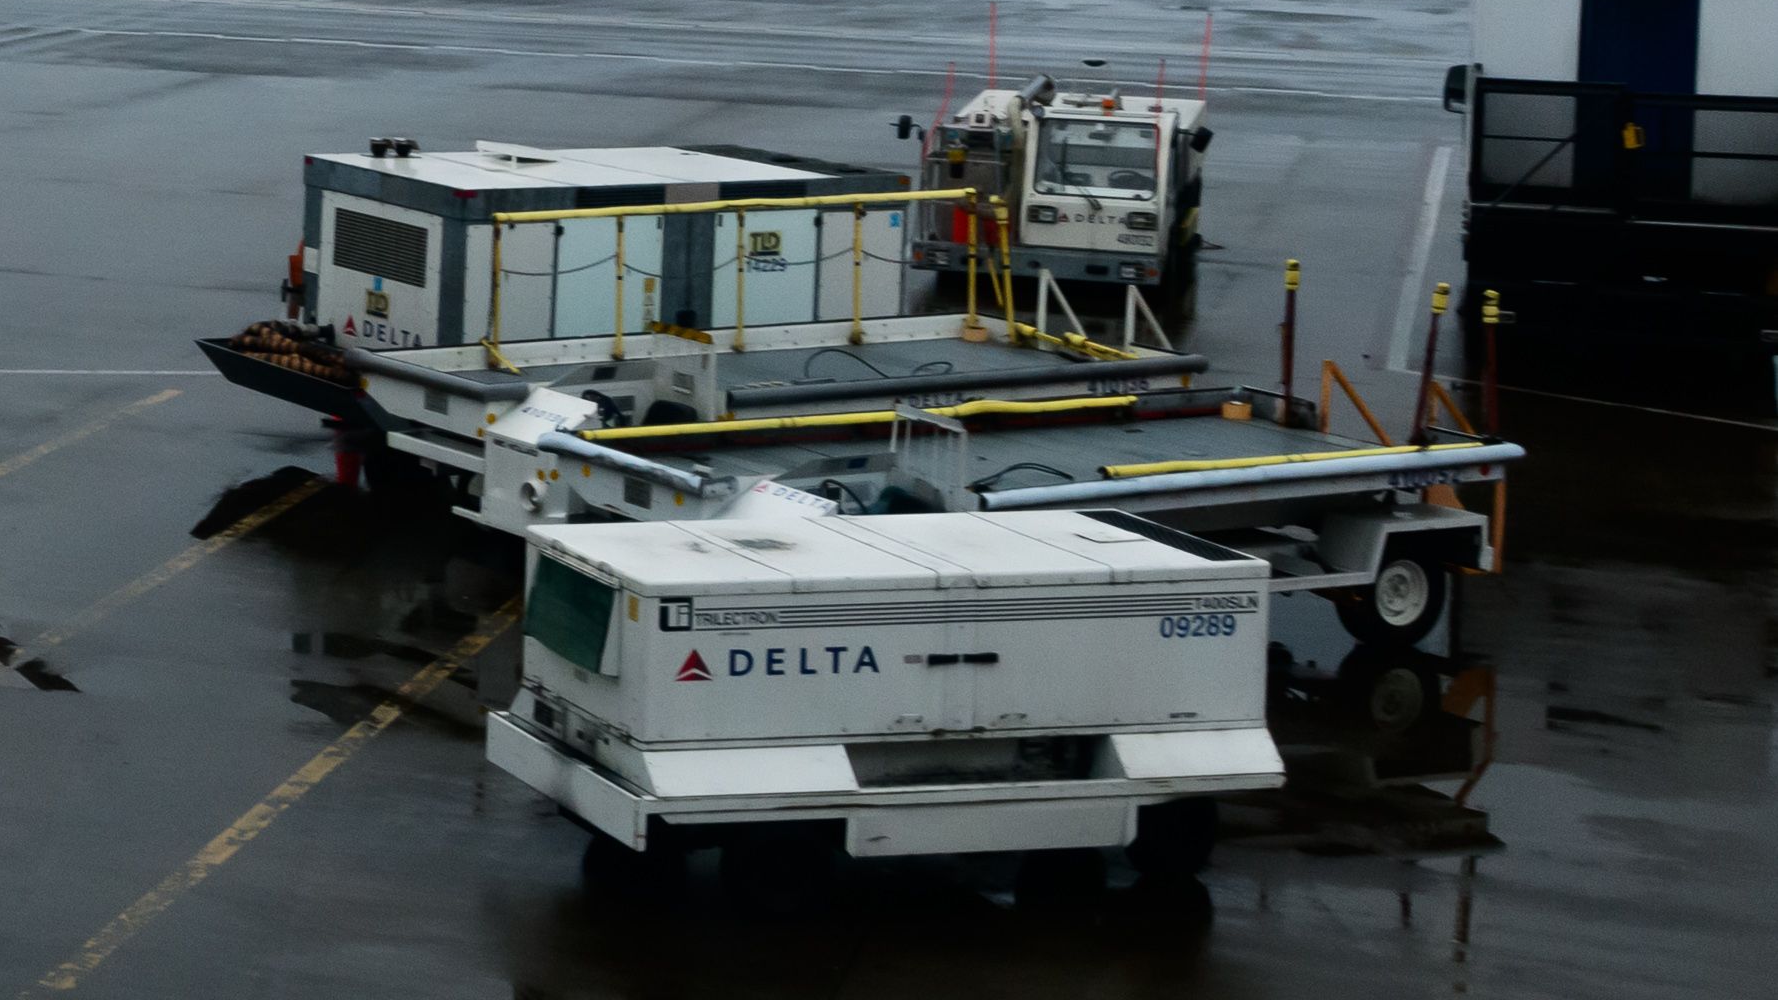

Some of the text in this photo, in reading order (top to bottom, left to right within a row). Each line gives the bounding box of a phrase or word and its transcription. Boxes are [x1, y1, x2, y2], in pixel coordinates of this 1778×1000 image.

[363, 320, 422, 347] DELTA
[773, 487, 833, 511] DELTA
[695, 611, 779, 626] TRILECTRON
[1160, 614, 1237, 638] 09289
[729, 646, 880, 677] DELTA
